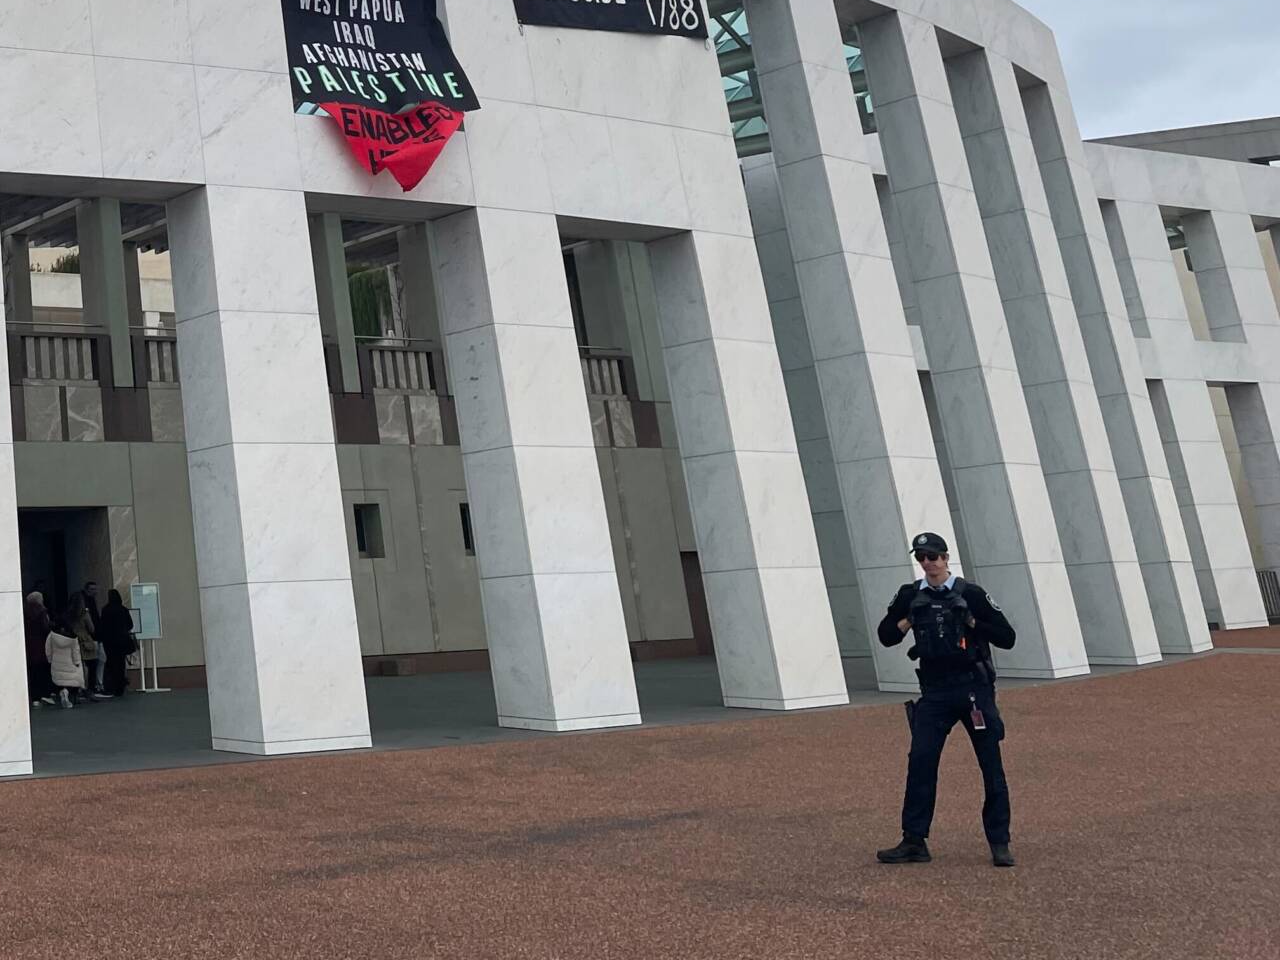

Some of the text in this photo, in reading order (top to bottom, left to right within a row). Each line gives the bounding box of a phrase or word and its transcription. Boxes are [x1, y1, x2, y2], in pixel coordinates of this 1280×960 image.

[333, 20, 376, 50] IRAQ
[302, 43, 426, 72] AFGHANISTAN
[293, 64, 464, 104] PALESTINE
